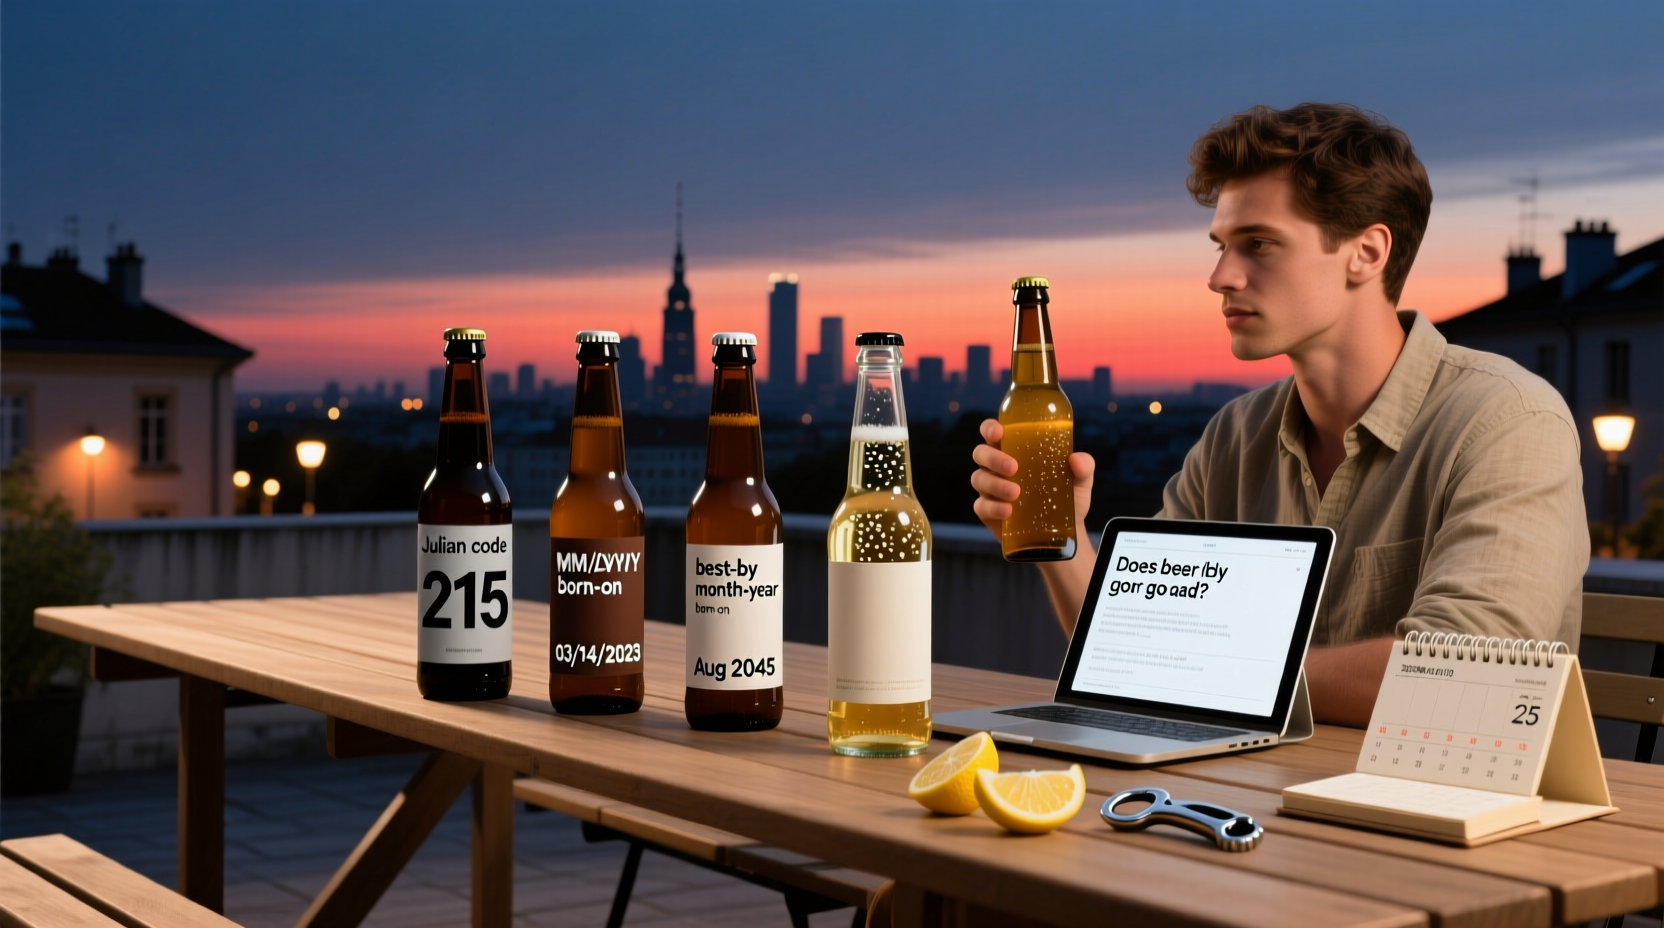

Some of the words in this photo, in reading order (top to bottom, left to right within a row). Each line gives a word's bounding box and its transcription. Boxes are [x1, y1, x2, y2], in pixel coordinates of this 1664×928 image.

[422, 536, 466, 554] Julian
[471, 536, 507, 554] code
[696, 557, 758, 581] best-by
[1116, 556, 1157, 574] Does
[1160, 558, 1199, 577] beer
[558, 575, 622, 595] born-on
[696, 581, 779, 602] month-year
[1145, 583, 1167, 600] go
[422, 570, 508, 629] 215
[555, 643, 641, 667] 03/14/2023
[694, 657, 726, 681] Aug
[731, 657, 775, 678] 2045
[1511, 704, 1541, 726] 25
